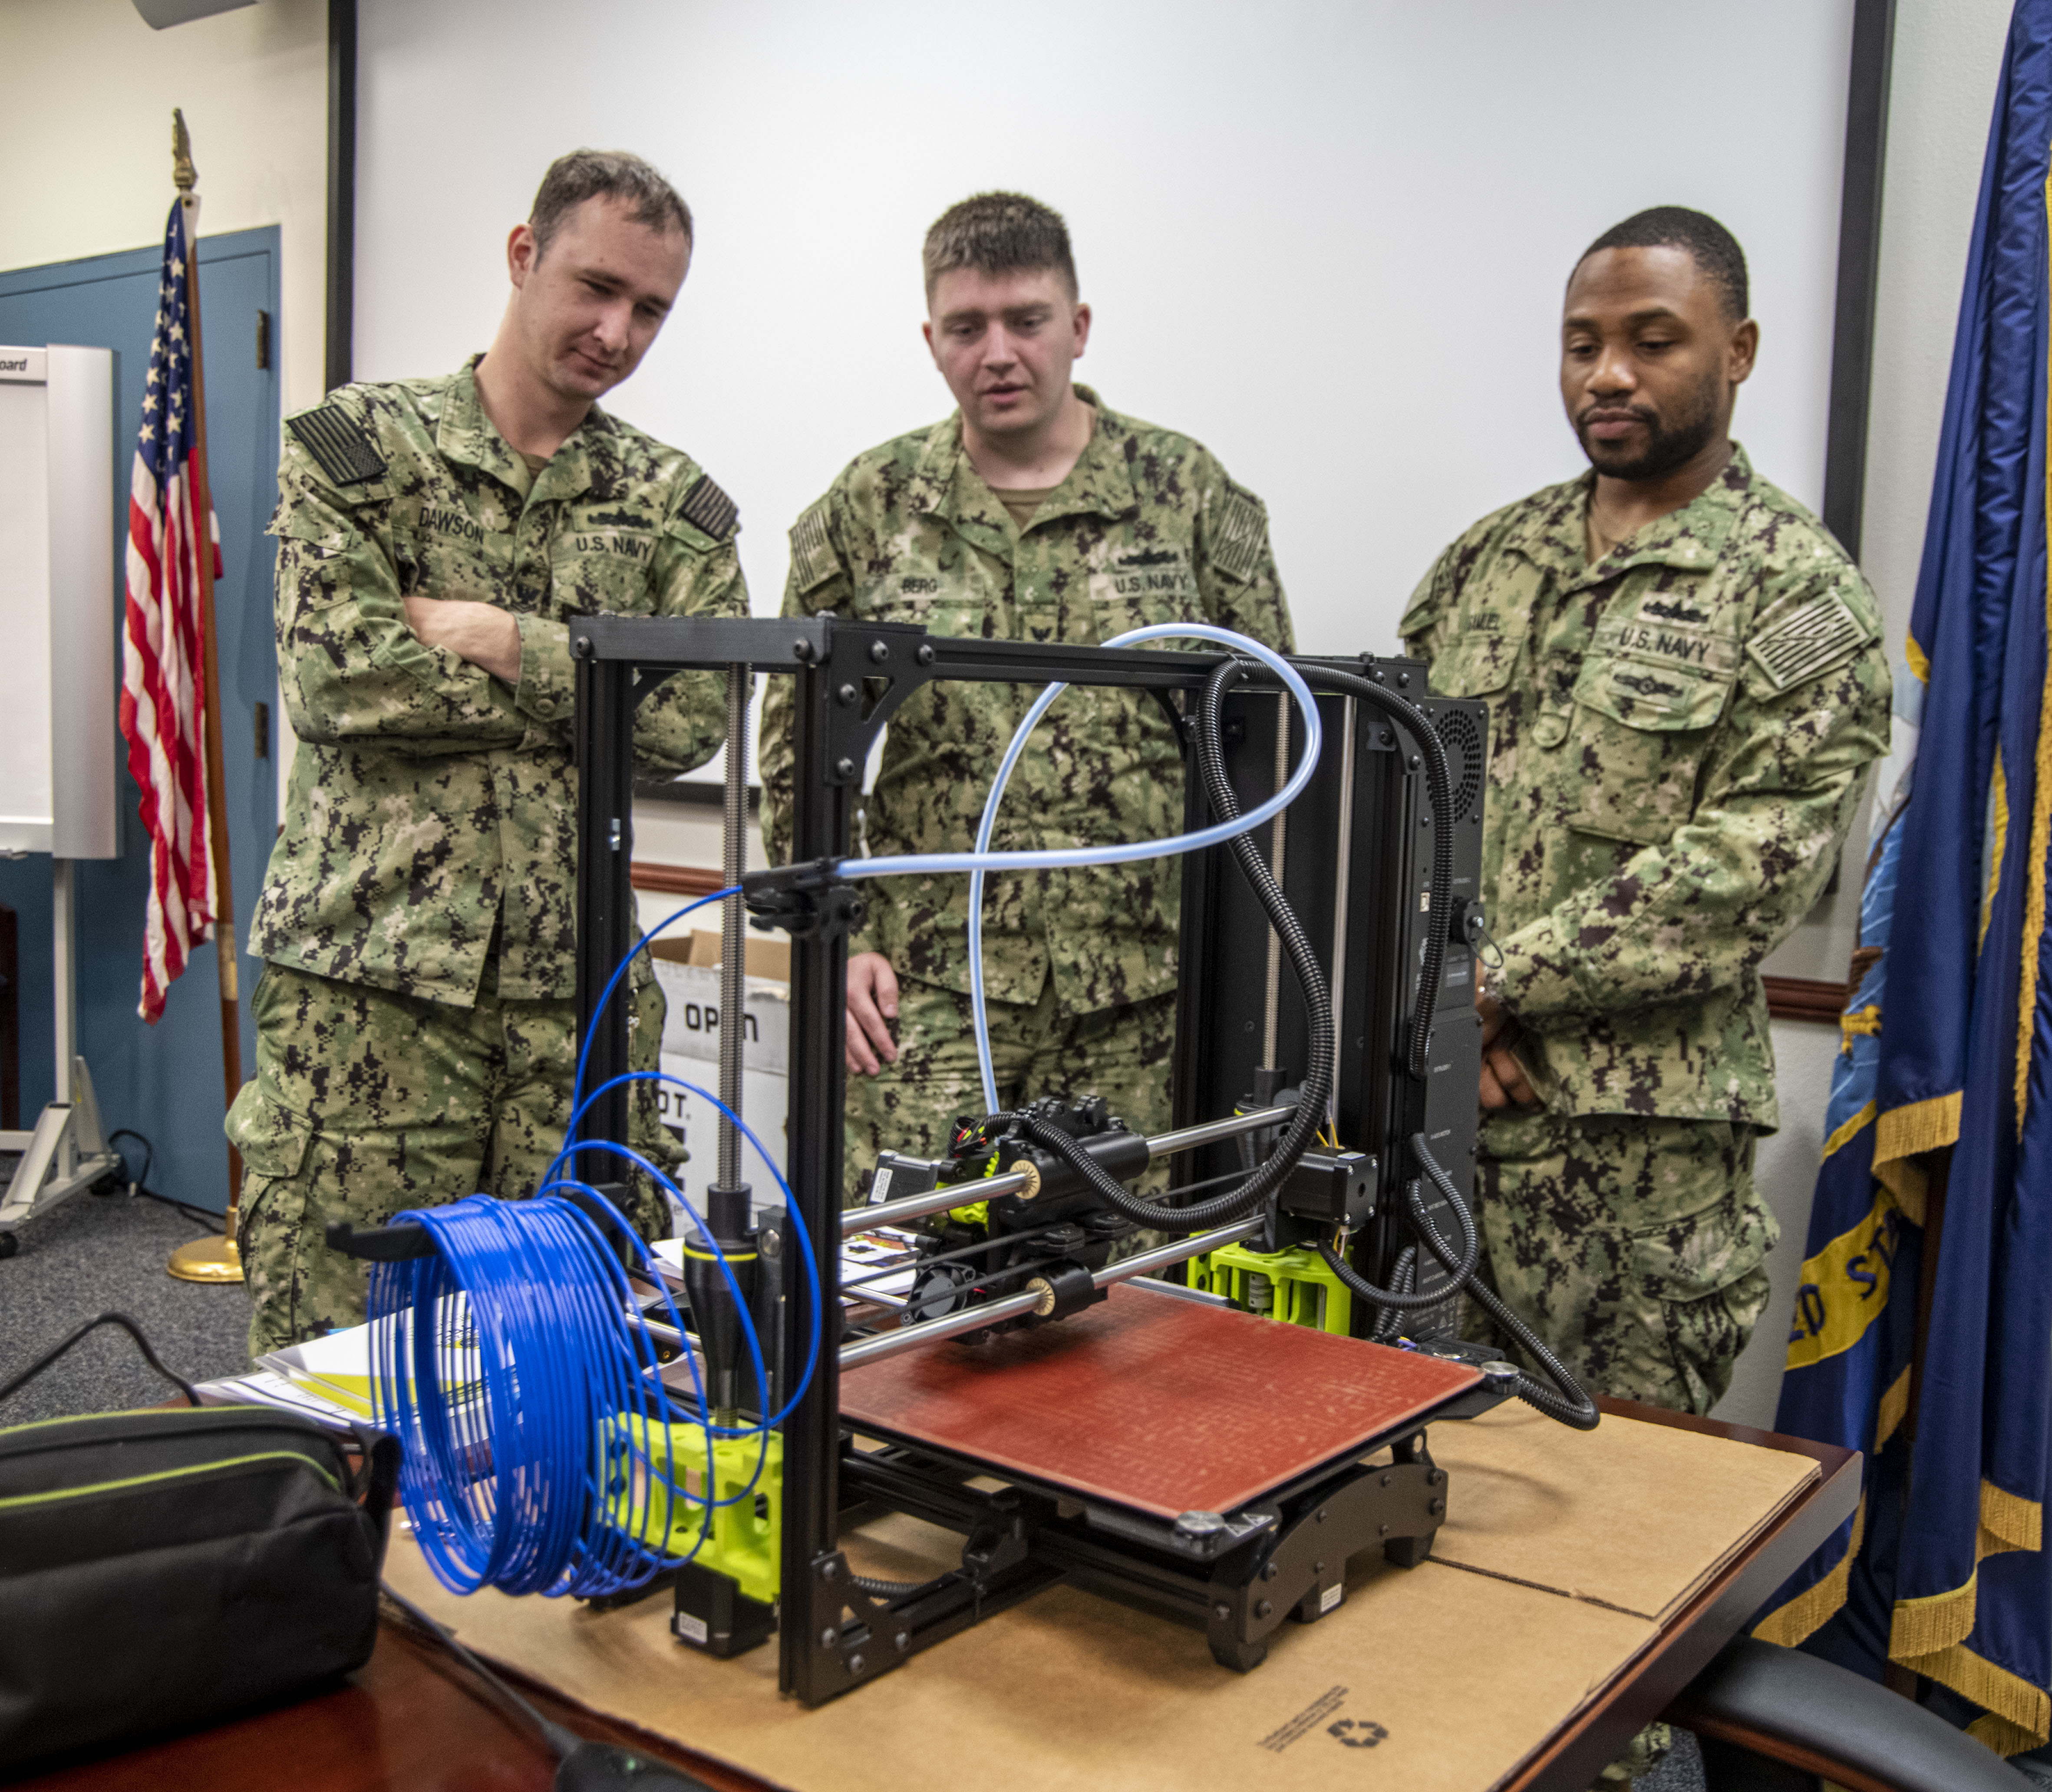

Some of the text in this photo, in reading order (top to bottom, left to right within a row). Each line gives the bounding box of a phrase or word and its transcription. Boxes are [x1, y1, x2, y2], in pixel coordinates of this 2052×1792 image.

[419, 507, 484, 544] DAWSON
[576, 536, 652, 562] U.S. NAVY
[1115, 573, 1188, 593] U.S. NAVY
[1619, 627, 1711, 663] U.S. NAVY
